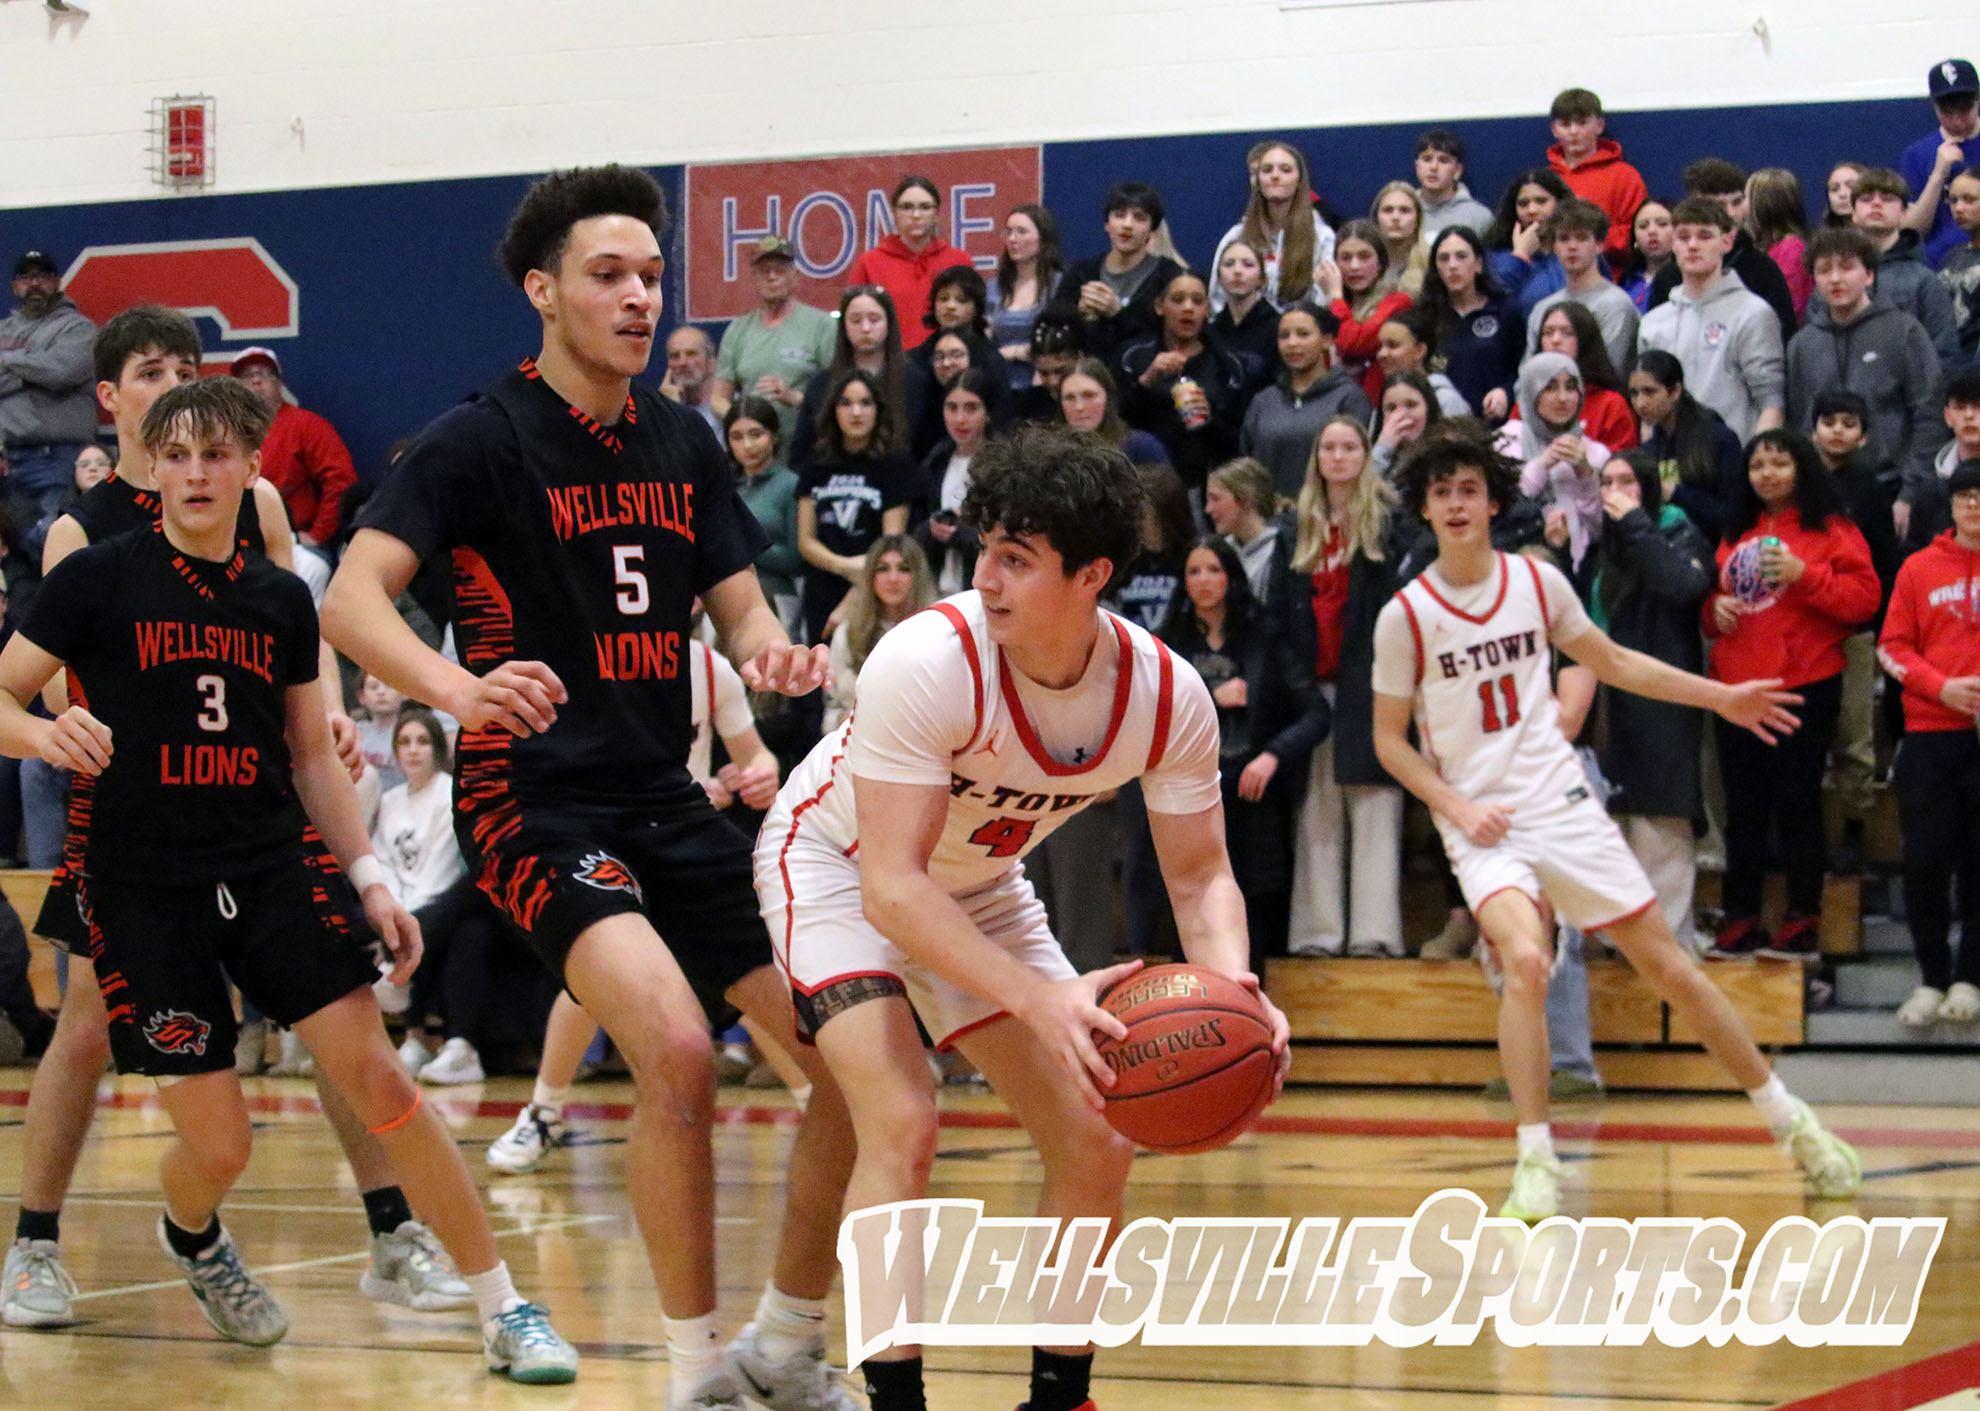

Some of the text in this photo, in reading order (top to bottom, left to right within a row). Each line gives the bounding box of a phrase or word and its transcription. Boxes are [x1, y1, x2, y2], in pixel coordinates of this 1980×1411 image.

[546, 482, 696, 545] WELLSVILLE
[612, 545, 650, 615] 5
[135, 621, 274, 684] WELLSVILLE
[1438, 630, 1538, 679] H-TOWN
[196, 674, 229, 732] 3
[1478, 674, 1520, 733] 11
[160, 744, 259, 785] LIONS
[950, 771, 1096, 812] H-TOW
[967, 816, 1040, 857] 4
[1104, 1017, 1227, 1074] SPALDING
